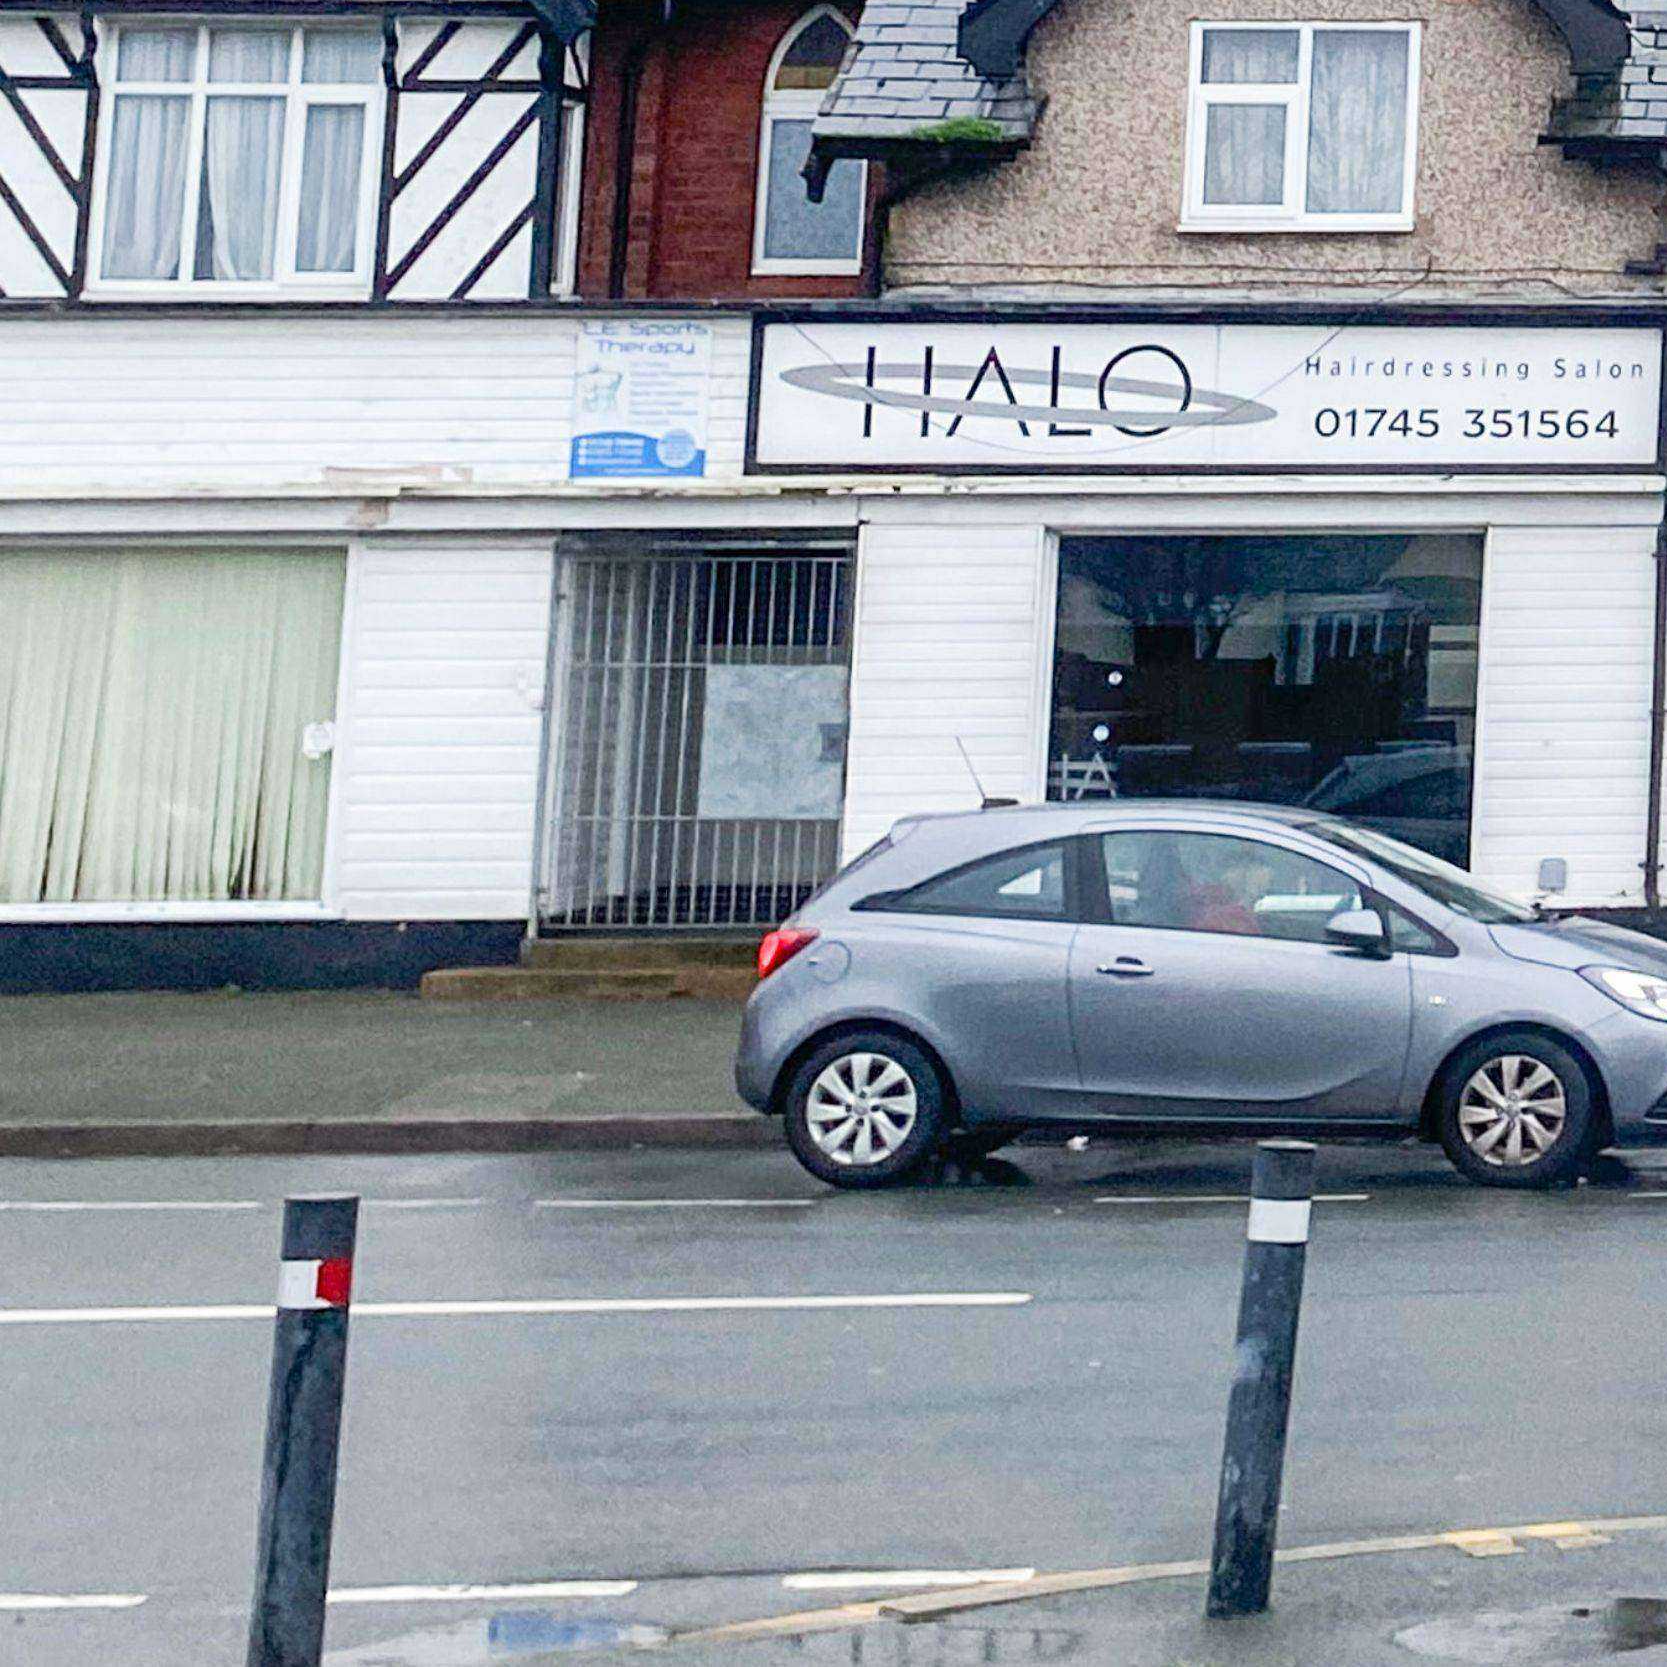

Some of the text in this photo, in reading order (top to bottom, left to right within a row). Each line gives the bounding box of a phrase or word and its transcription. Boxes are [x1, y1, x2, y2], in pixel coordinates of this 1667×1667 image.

[597, 337, 696, 356] Therapy
[1304, 356, 1643, 380] Hairdressing Salon
[862, 344, 1193, 438] HALO
[1314, 407, 1619, 440] 01745 351564
